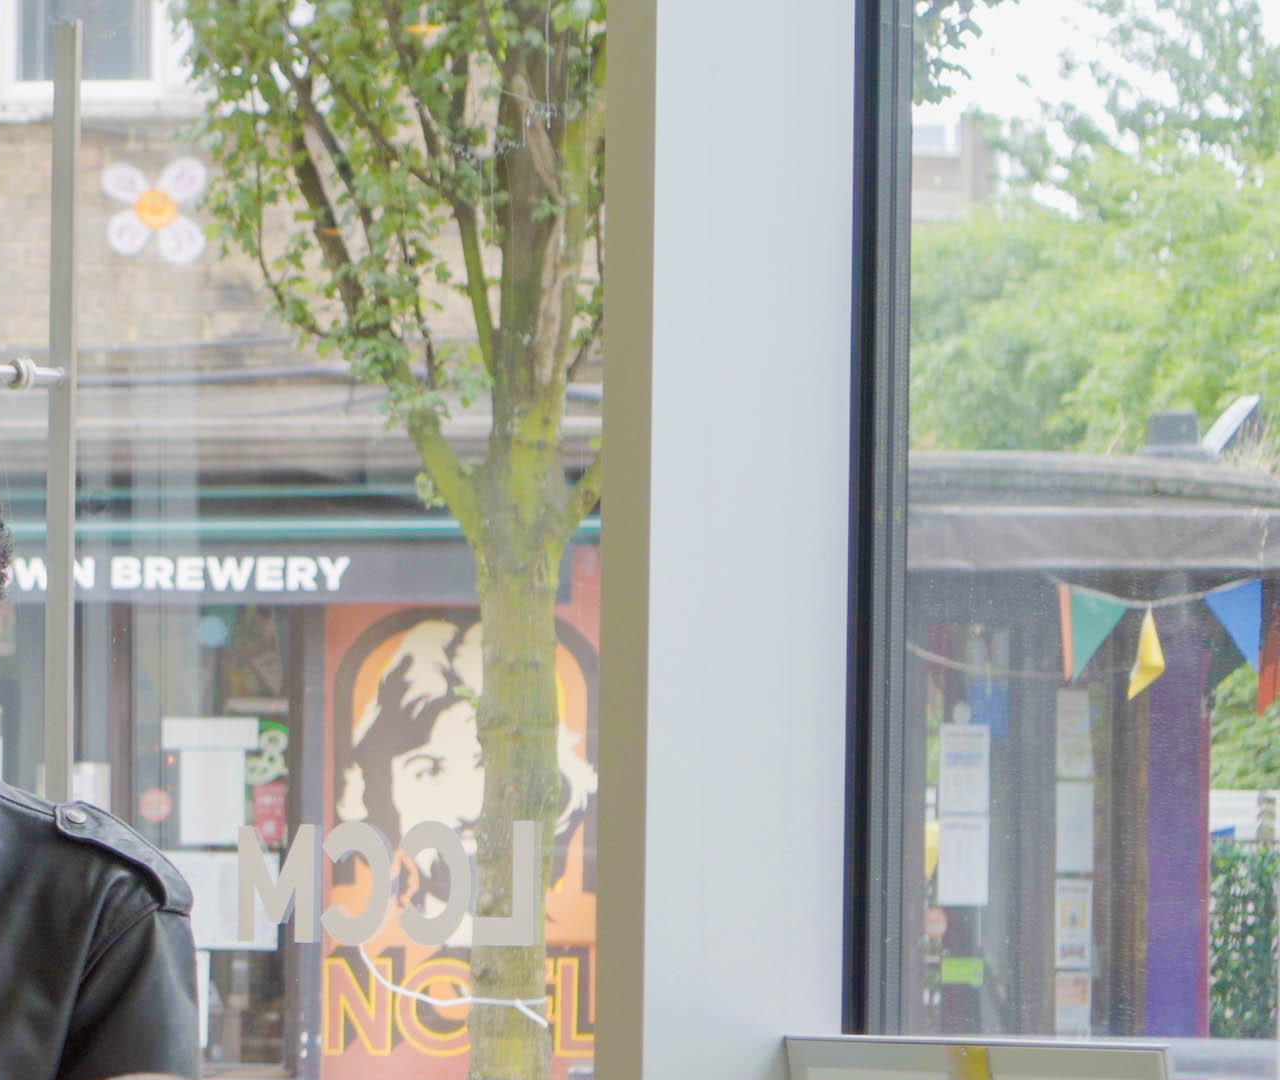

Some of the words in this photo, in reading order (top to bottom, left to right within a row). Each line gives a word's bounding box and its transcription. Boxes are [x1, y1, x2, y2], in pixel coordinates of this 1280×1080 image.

[6, 556, 96, 591] WN
[109, 556, 351, 591] BREWERY
[322, 957, 595, 1058] NOL
